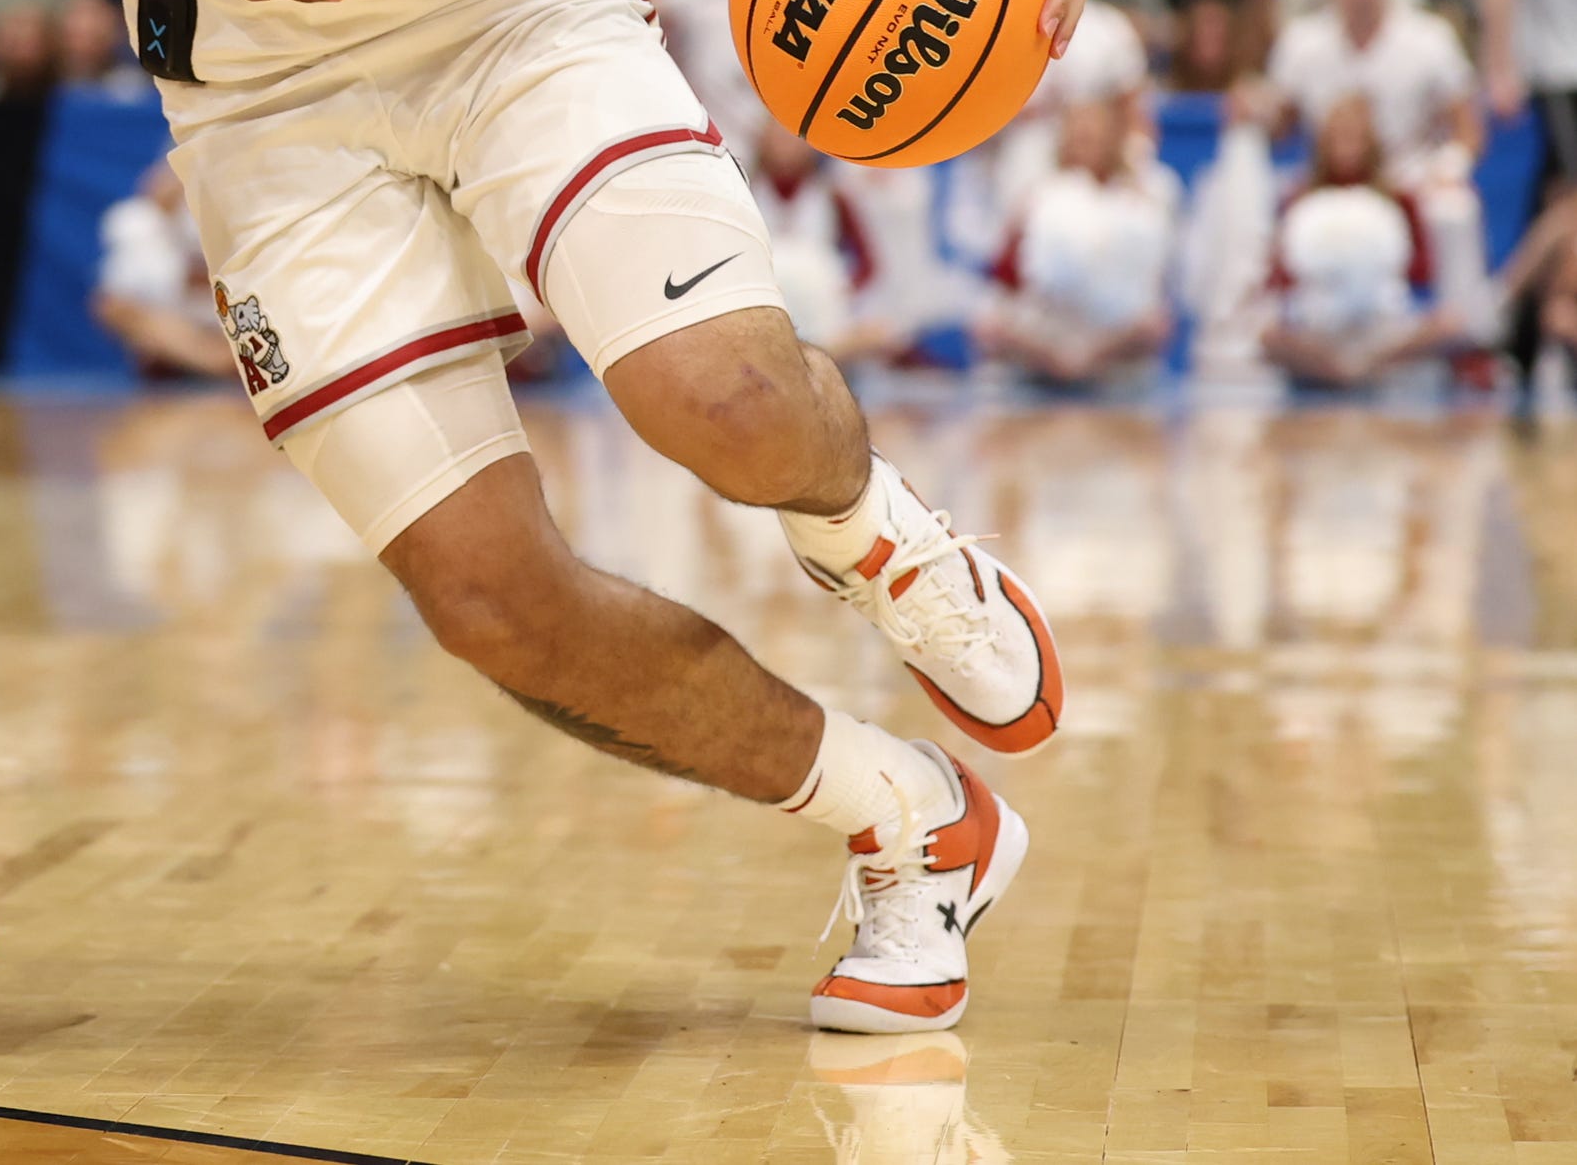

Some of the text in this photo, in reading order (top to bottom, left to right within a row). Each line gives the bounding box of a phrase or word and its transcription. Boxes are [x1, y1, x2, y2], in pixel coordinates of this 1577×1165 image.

[763, 0, 782, 35] BALL
[867, 3, 908, 64] EVO NXT
